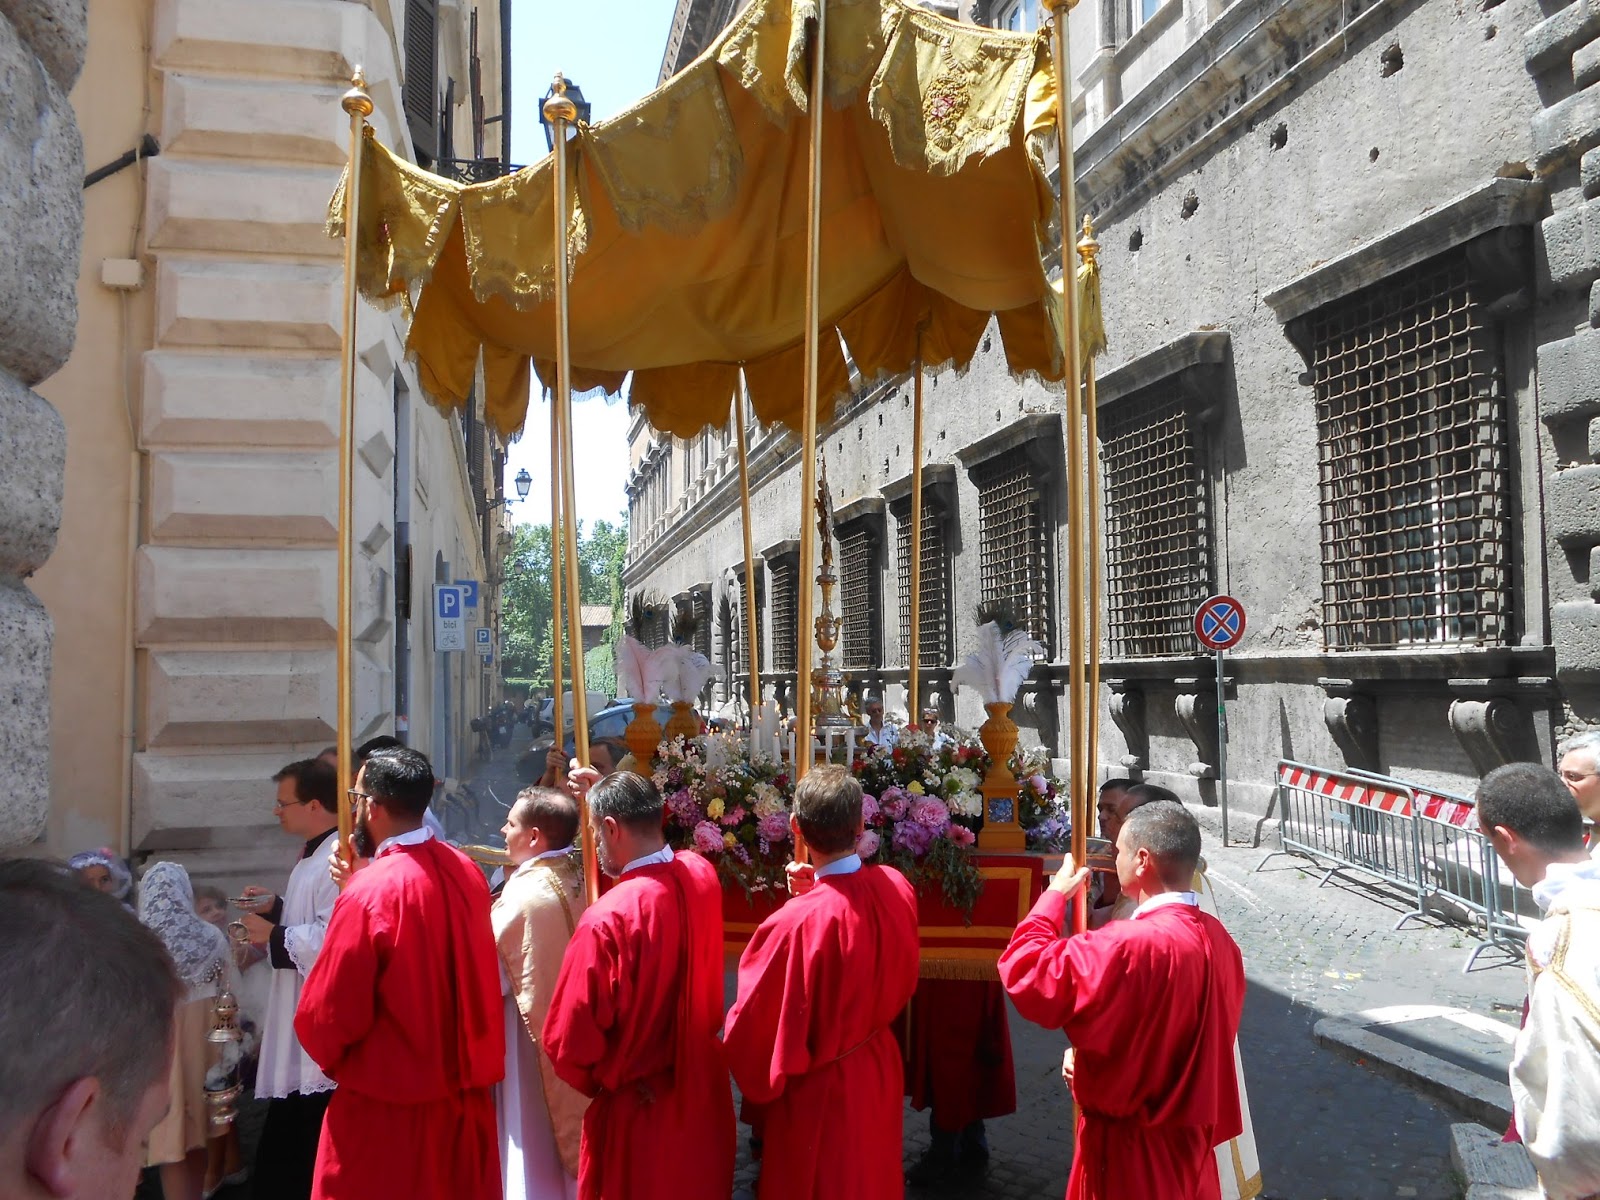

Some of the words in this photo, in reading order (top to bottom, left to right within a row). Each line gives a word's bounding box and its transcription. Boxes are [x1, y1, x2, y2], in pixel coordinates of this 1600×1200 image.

[444, 594, 455, 614] P
[443, 620, 457, 629] bici
[479, 631, 488, 642] P
